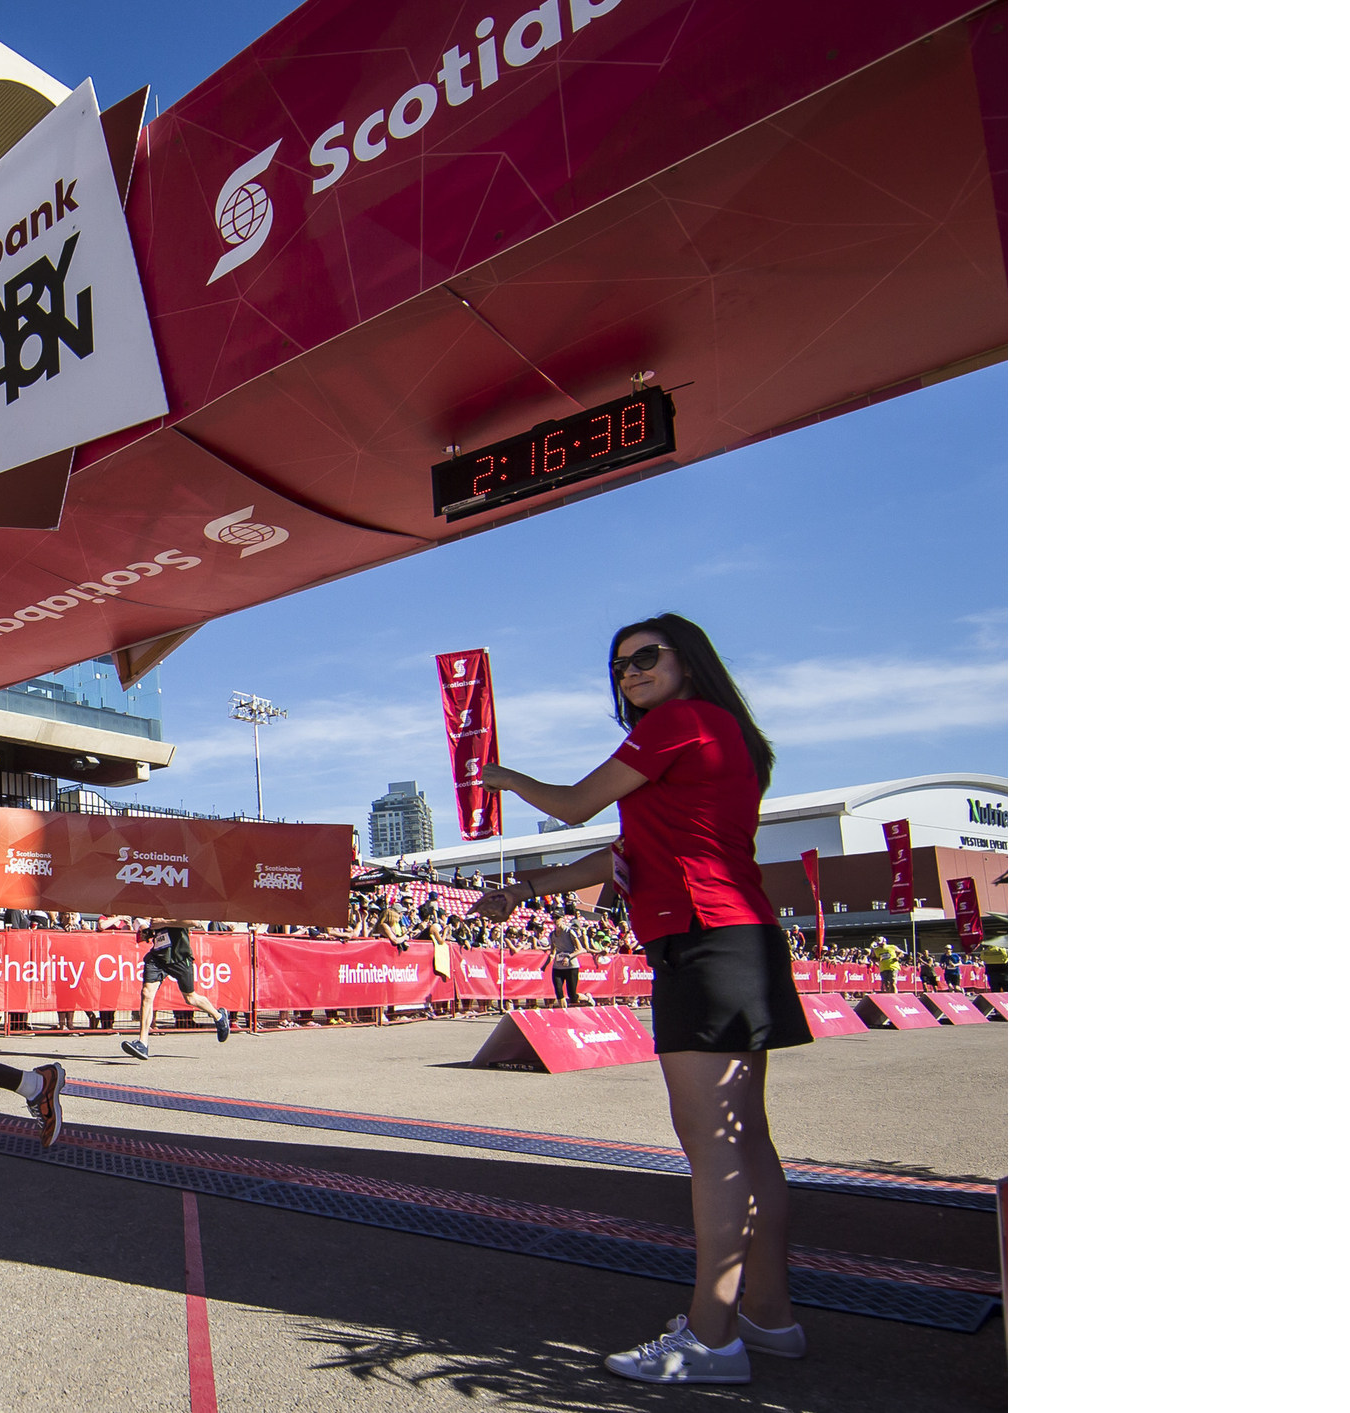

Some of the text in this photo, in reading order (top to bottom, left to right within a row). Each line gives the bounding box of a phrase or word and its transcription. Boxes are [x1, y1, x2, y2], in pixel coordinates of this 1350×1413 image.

[16, 850, 52, 858] Scotiabank
[133, 851, 189, 863] Scotiabank
[116, 863, 189, 888] 42.2KM
[338, 962, 419, 984] #InfinitePotential
